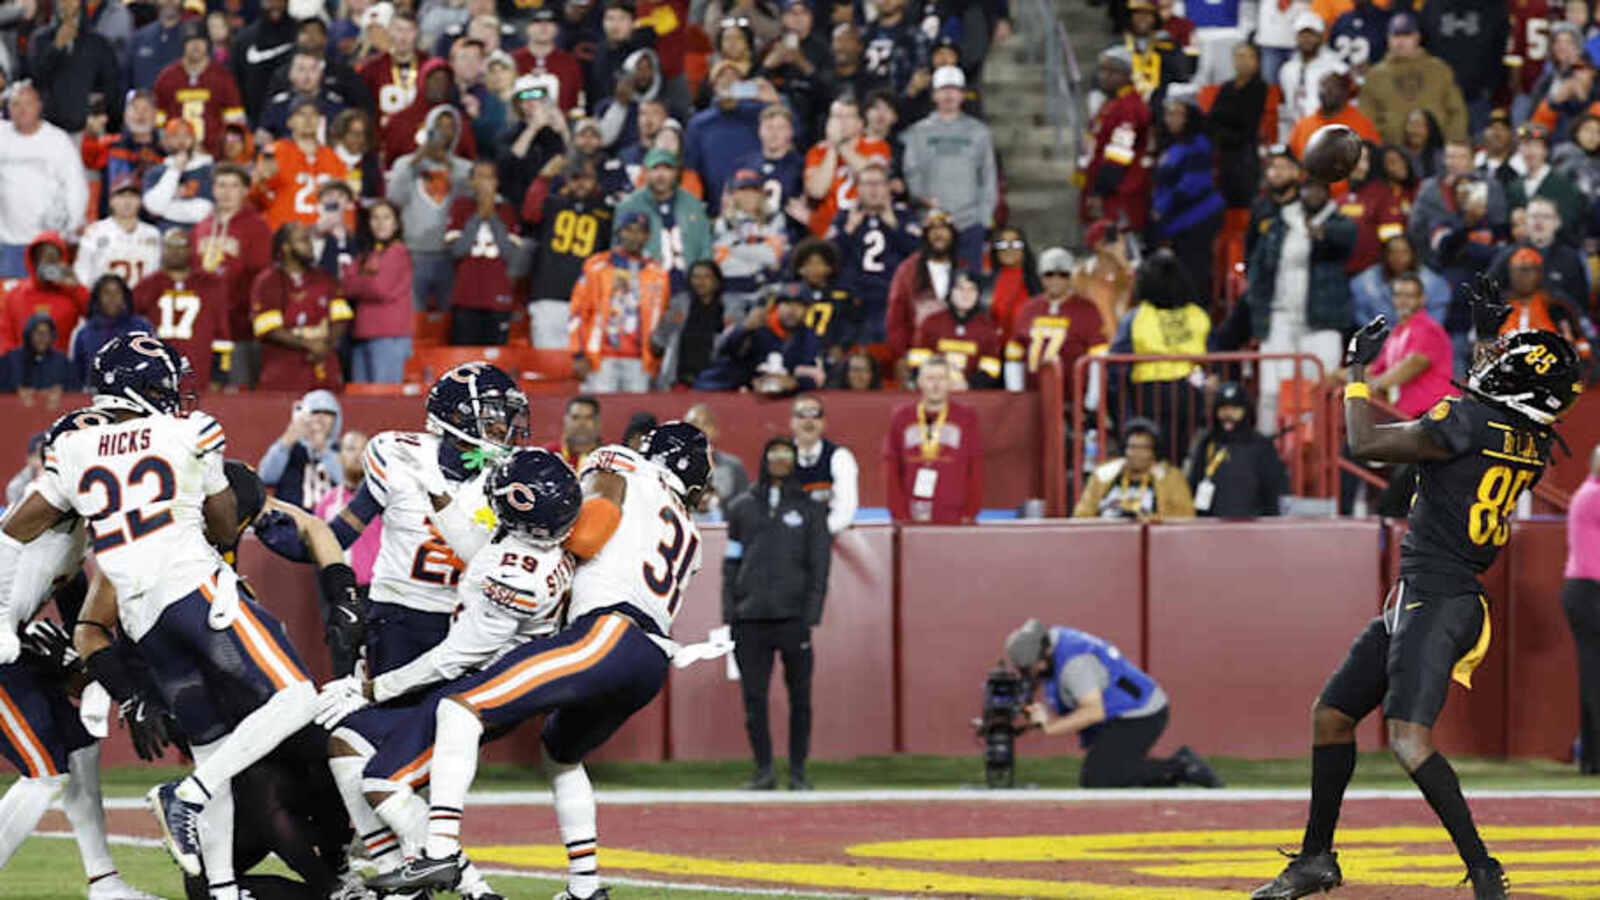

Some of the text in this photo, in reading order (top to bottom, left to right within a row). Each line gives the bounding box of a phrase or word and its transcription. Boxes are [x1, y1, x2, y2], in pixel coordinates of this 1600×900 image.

[551, 209, 599, 258] 99
[862, 229, 886, 272] 2
[158, 293, 201, 340] 17
[1525, 345, 1558, 374] 85
[97, 428, 152, 458] HICKS
[78, 455, 178, 555] 22
[1468, 465, 1535, 547] 85
[500, 552, 539, 574] 29
[642, 505, 699, 616] 31
